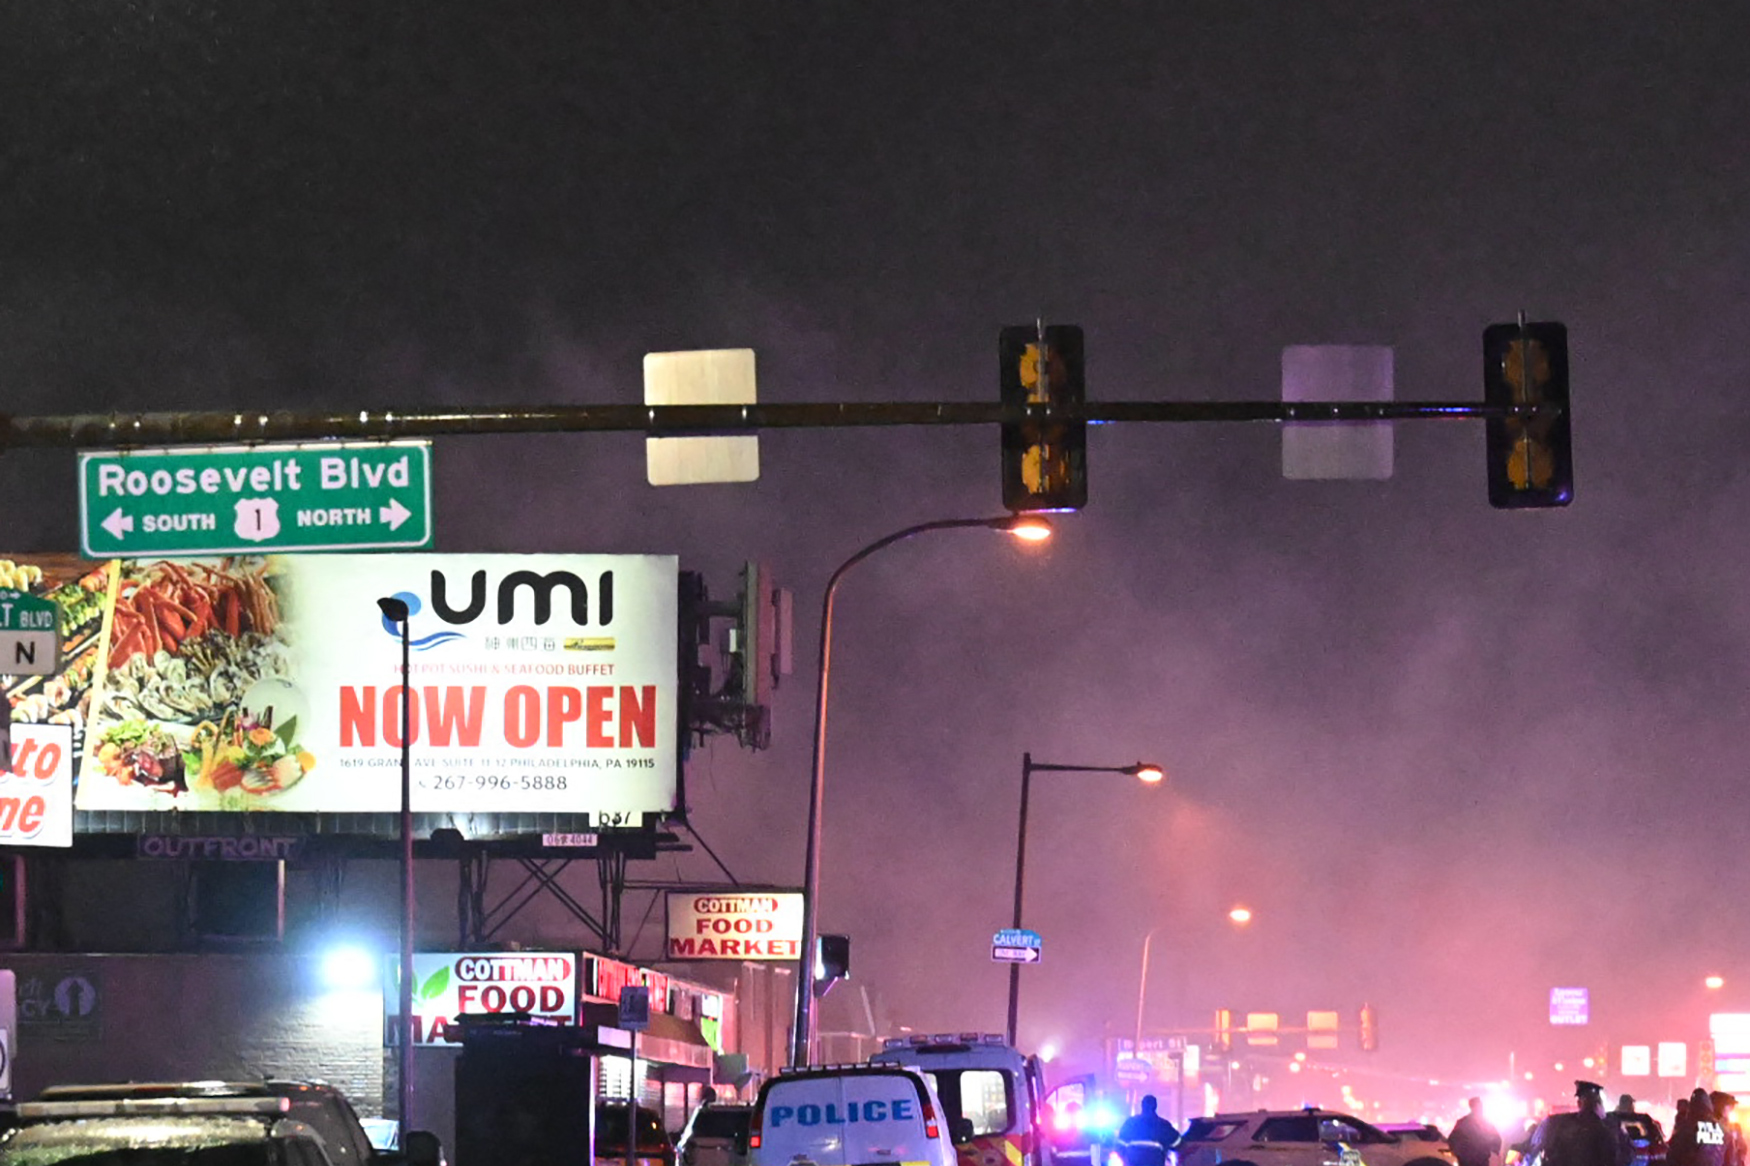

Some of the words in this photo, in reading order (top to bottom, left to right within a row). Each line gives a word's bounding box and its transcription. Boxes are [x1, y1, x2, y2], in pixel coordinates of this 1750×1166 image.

[99, 460, 301, 496] Roosevelt
[320, 456, 410, 490] Blvd
[142, 513, 216, 532] SOUTH
[254, 508, 261, 531] 1
[297, 508, 371, 527] NORTH
[19, 610, 53, 627] BLVD
[16, 641, 35, 664] N
[504, 663, 564, 675] SEAFOOD
[567, 663, 615, 676] BUFFET
[339, 685, 488, 748] NOW
[503, 684, 656, 748] OPEN
[367, 758, 403, 768] GRAN
[606, 757, 623, 768] PA
[626, 757, 655, 768] 19115
[433, 775, 568, 790] 267-996-5888
[144, 836, 297, 856] OUTFRONT
[698, 898, 772, 912] COTTMAN
[696, 918, 773, 934] FOOD
[669, 938, 799, 956] MARKET
[459, 957, 564, 981] COTTMAN
[458, 985, 565, 1013] FOOD
[771, 1099, 914, 1127] POLICE
